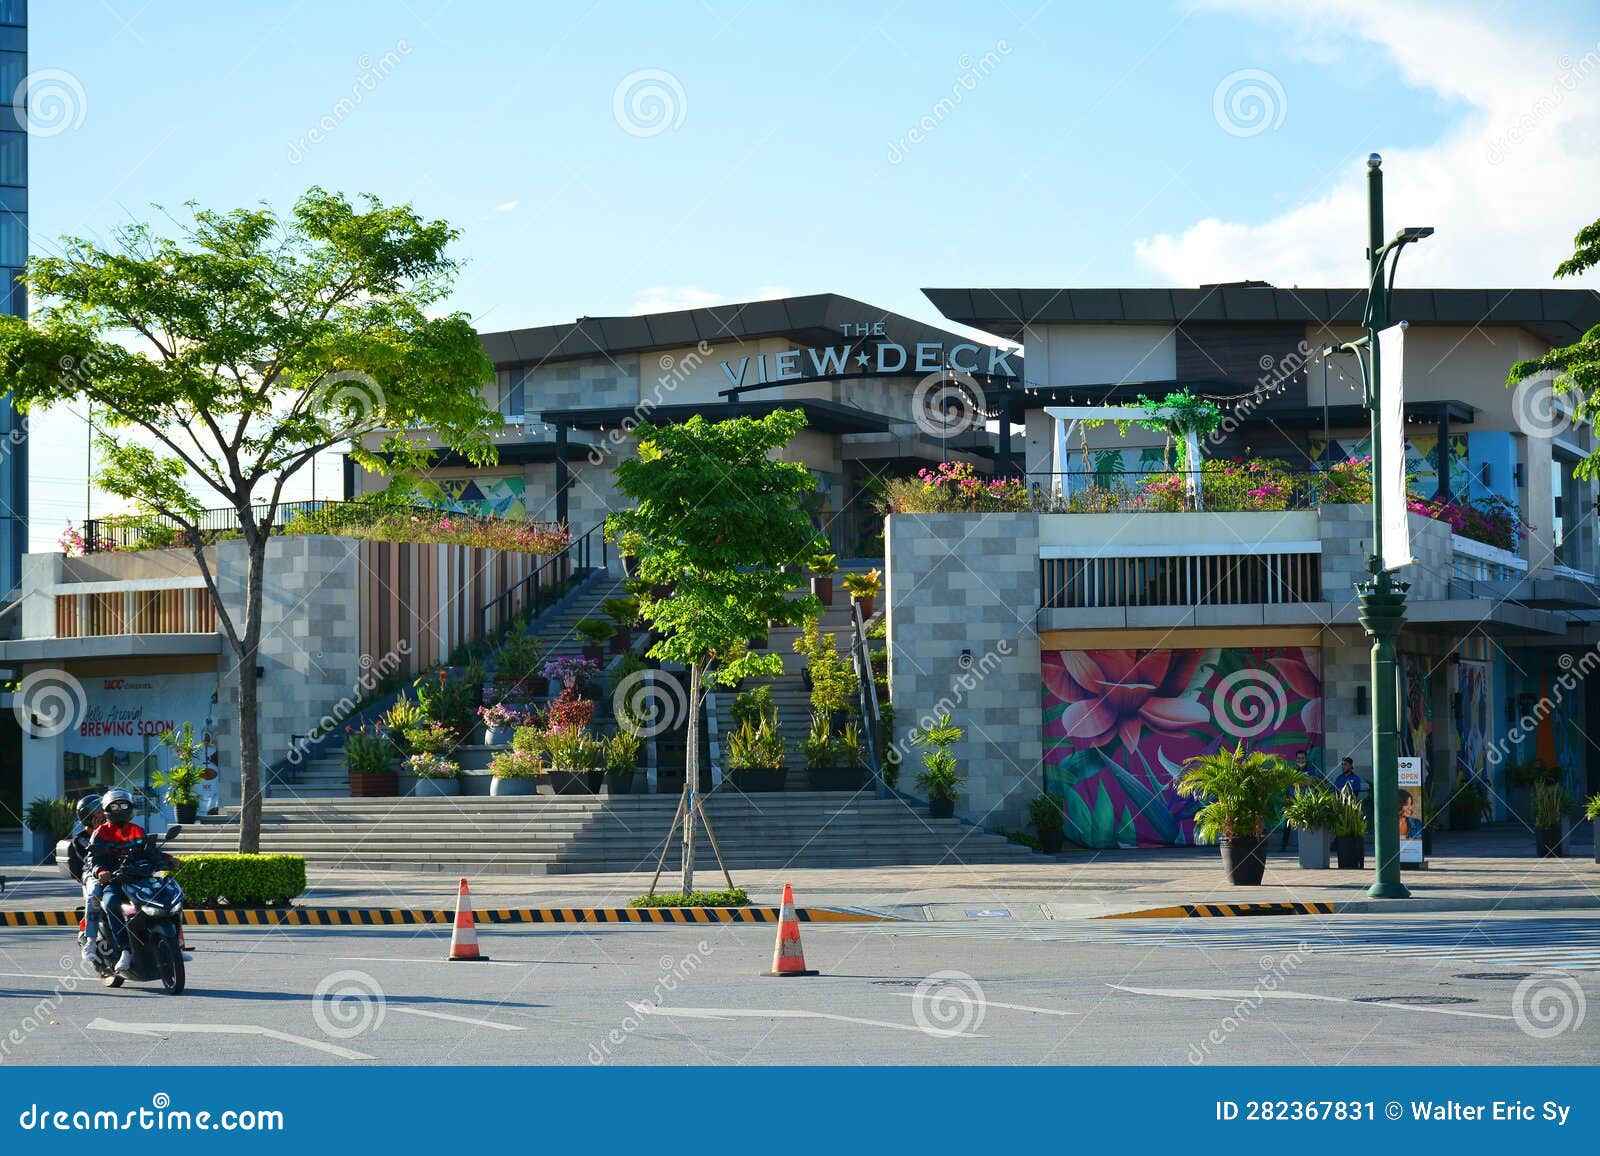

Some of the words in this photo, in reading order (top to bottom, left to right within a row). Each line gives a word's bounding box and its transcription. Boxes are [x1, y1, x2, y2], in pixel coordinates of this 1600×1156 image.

[839, 321, 886, 337] THE
[719, 344, 853, 389] VIEW
[876, 342, 1021, 378] DECK
[80, 721, 134, 737] BREWING
[137, 719, 175, 736] SOON
